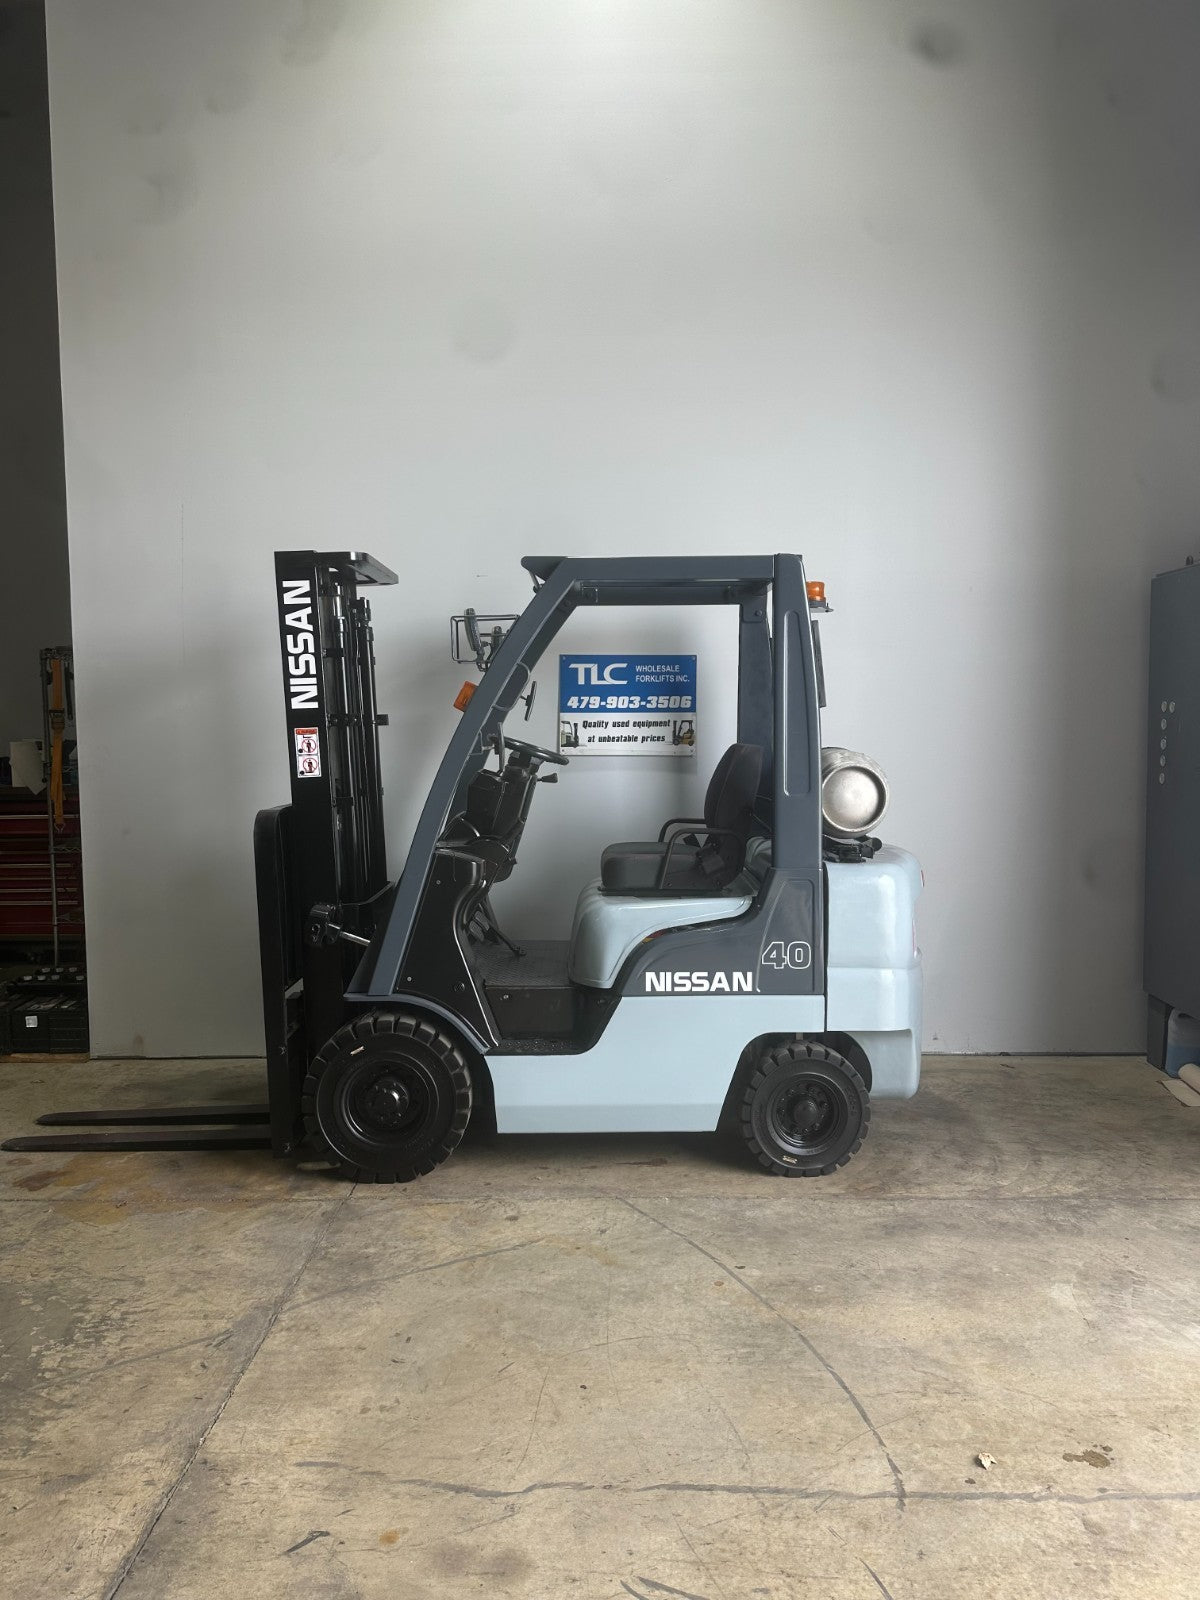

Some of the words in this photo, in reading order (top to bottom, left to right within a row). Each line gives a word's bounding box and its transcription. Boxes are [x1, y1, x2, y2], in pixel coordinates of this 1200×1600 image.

[282, 580, 319, 710] NISSAN
[568, 663, 628, 685] TLC
[635, 675, 674, 683] FORKLIFTS
[675, 675, 690, 683] INC.
[567, 696, 692, 709] 479-903-3506
[582, 720, 609, 729] Quality
[612, 720, 630, 728] used
[632, 719, 671, 729] equipment
[587, 734, 596, 743] at
[598, 734, 638, 743] unbeatable
[641, 734, 666, 744] prices
[761, 941, 812, 970] 40
[645, 971, 753, 992] NISSAN
